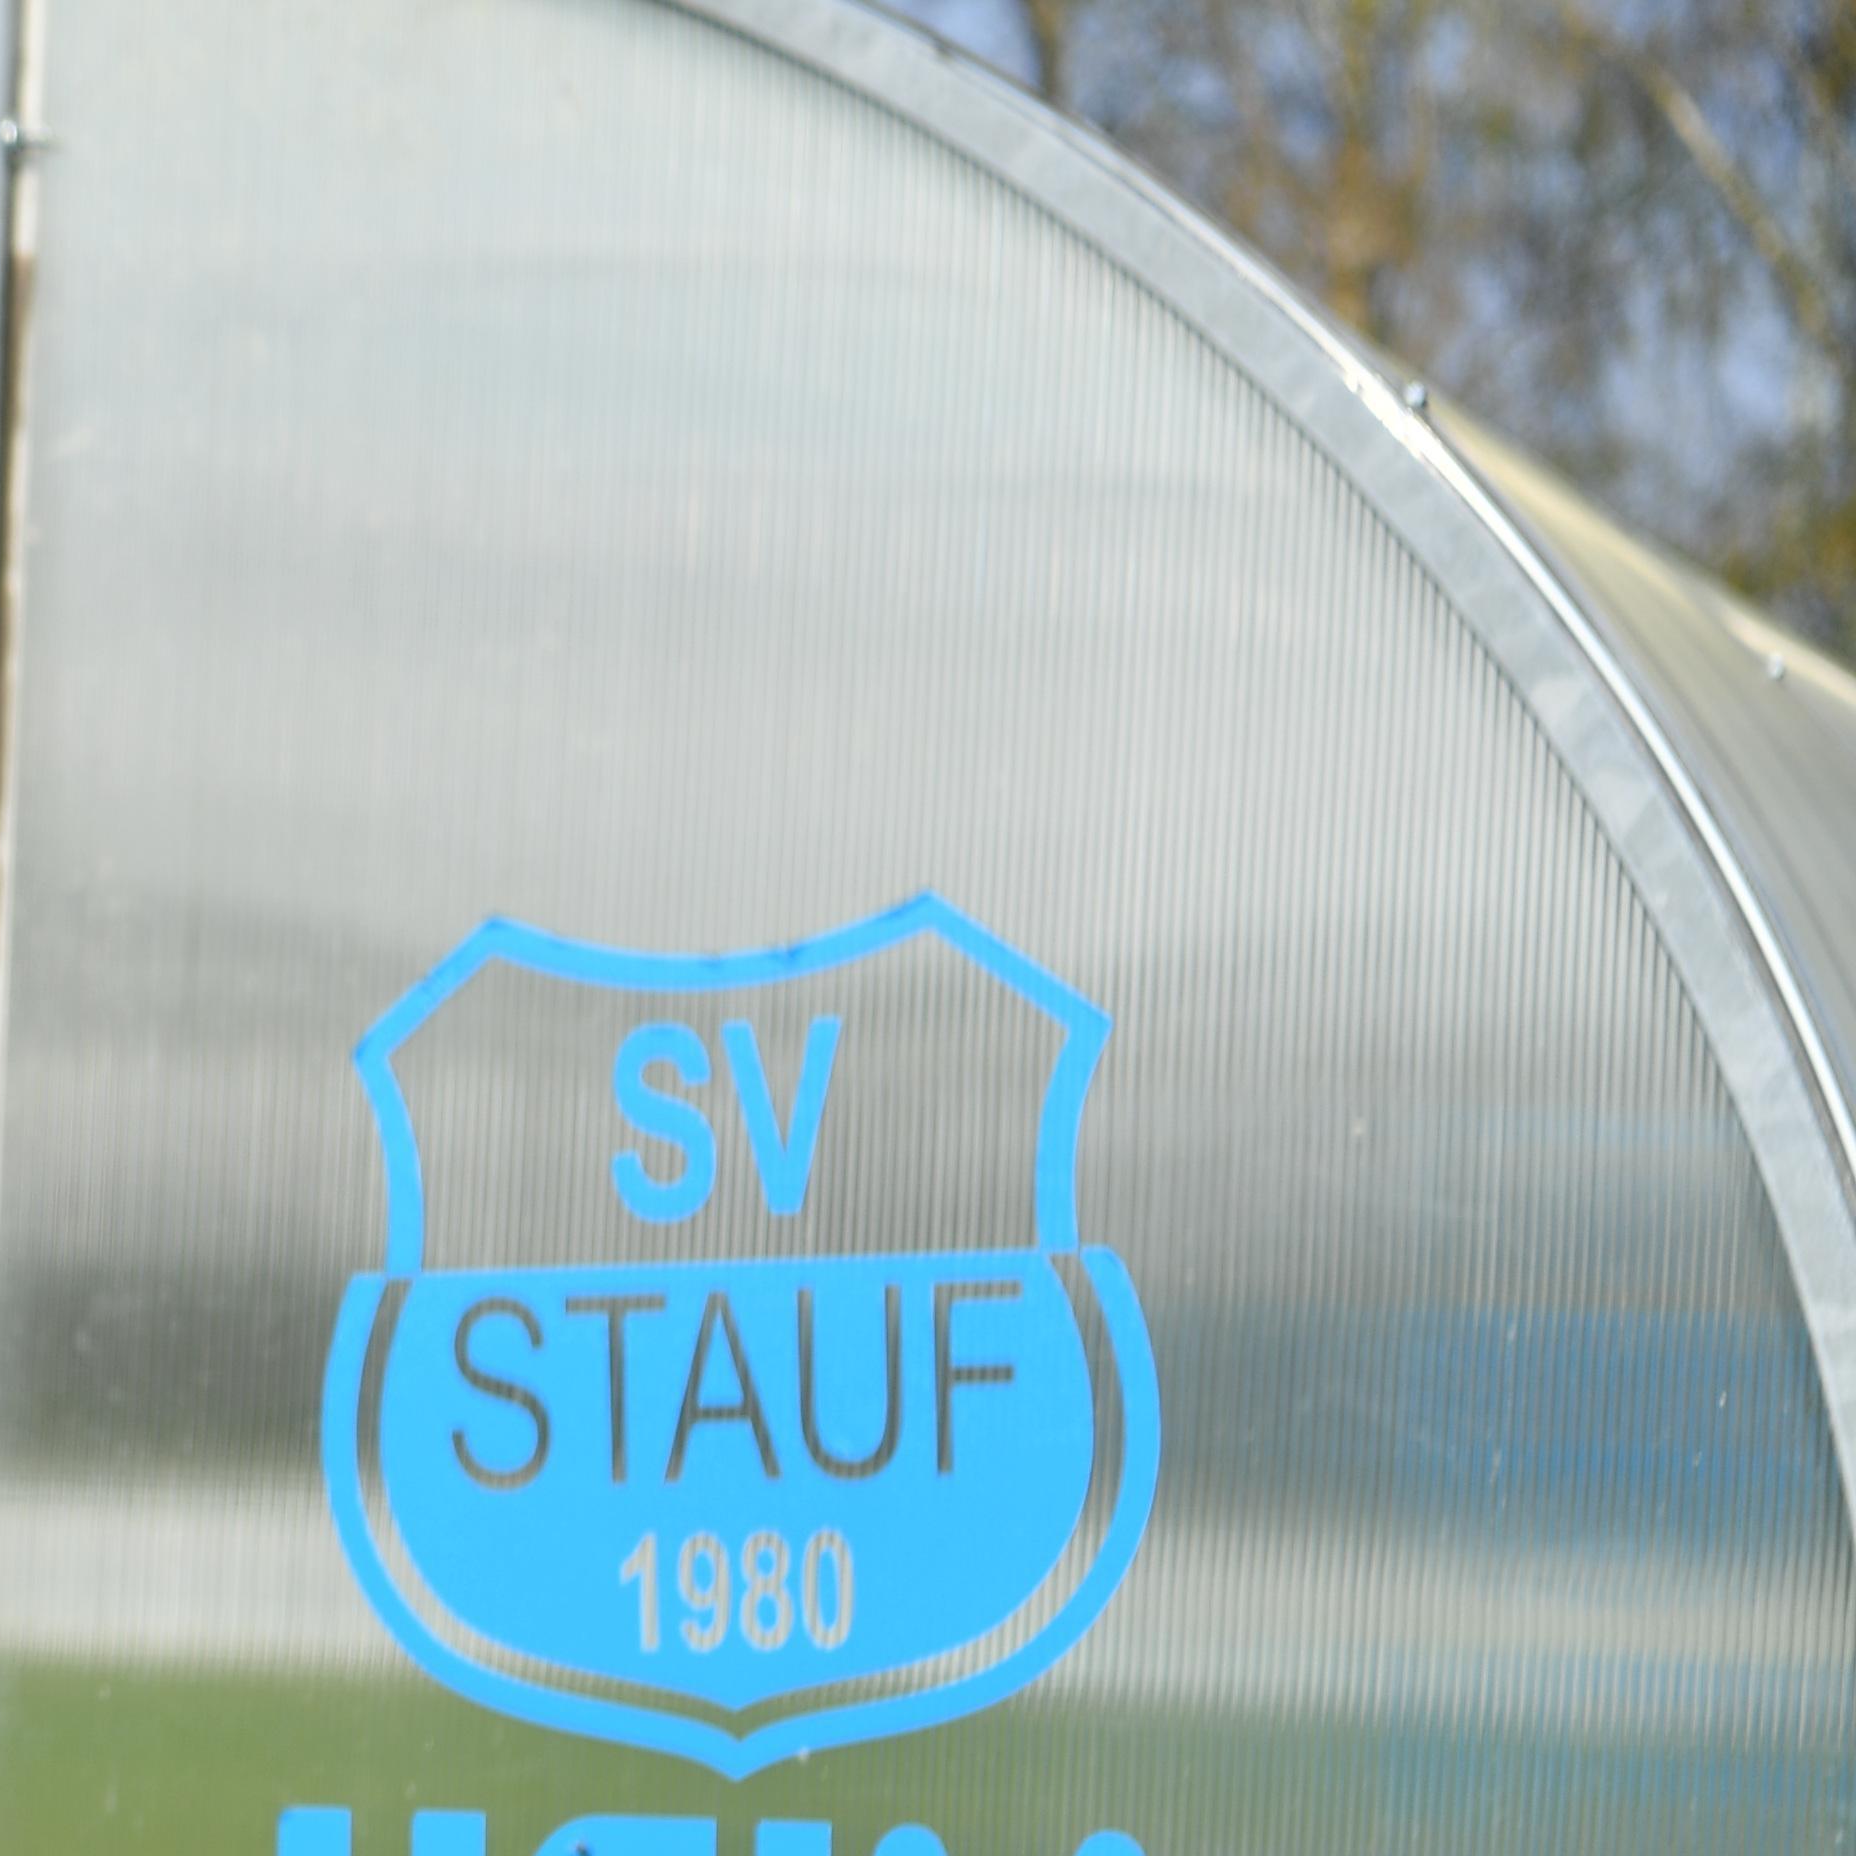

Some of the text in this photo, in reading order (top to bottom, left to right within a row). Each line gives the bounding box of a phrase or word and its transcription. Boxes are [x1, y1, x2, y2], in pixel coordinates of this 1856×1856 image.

[611, 1017, 841, 1223] SV
[451, 1279, 1023, 1491] STAUF
[619, 1528, 856, 1653] 1980
